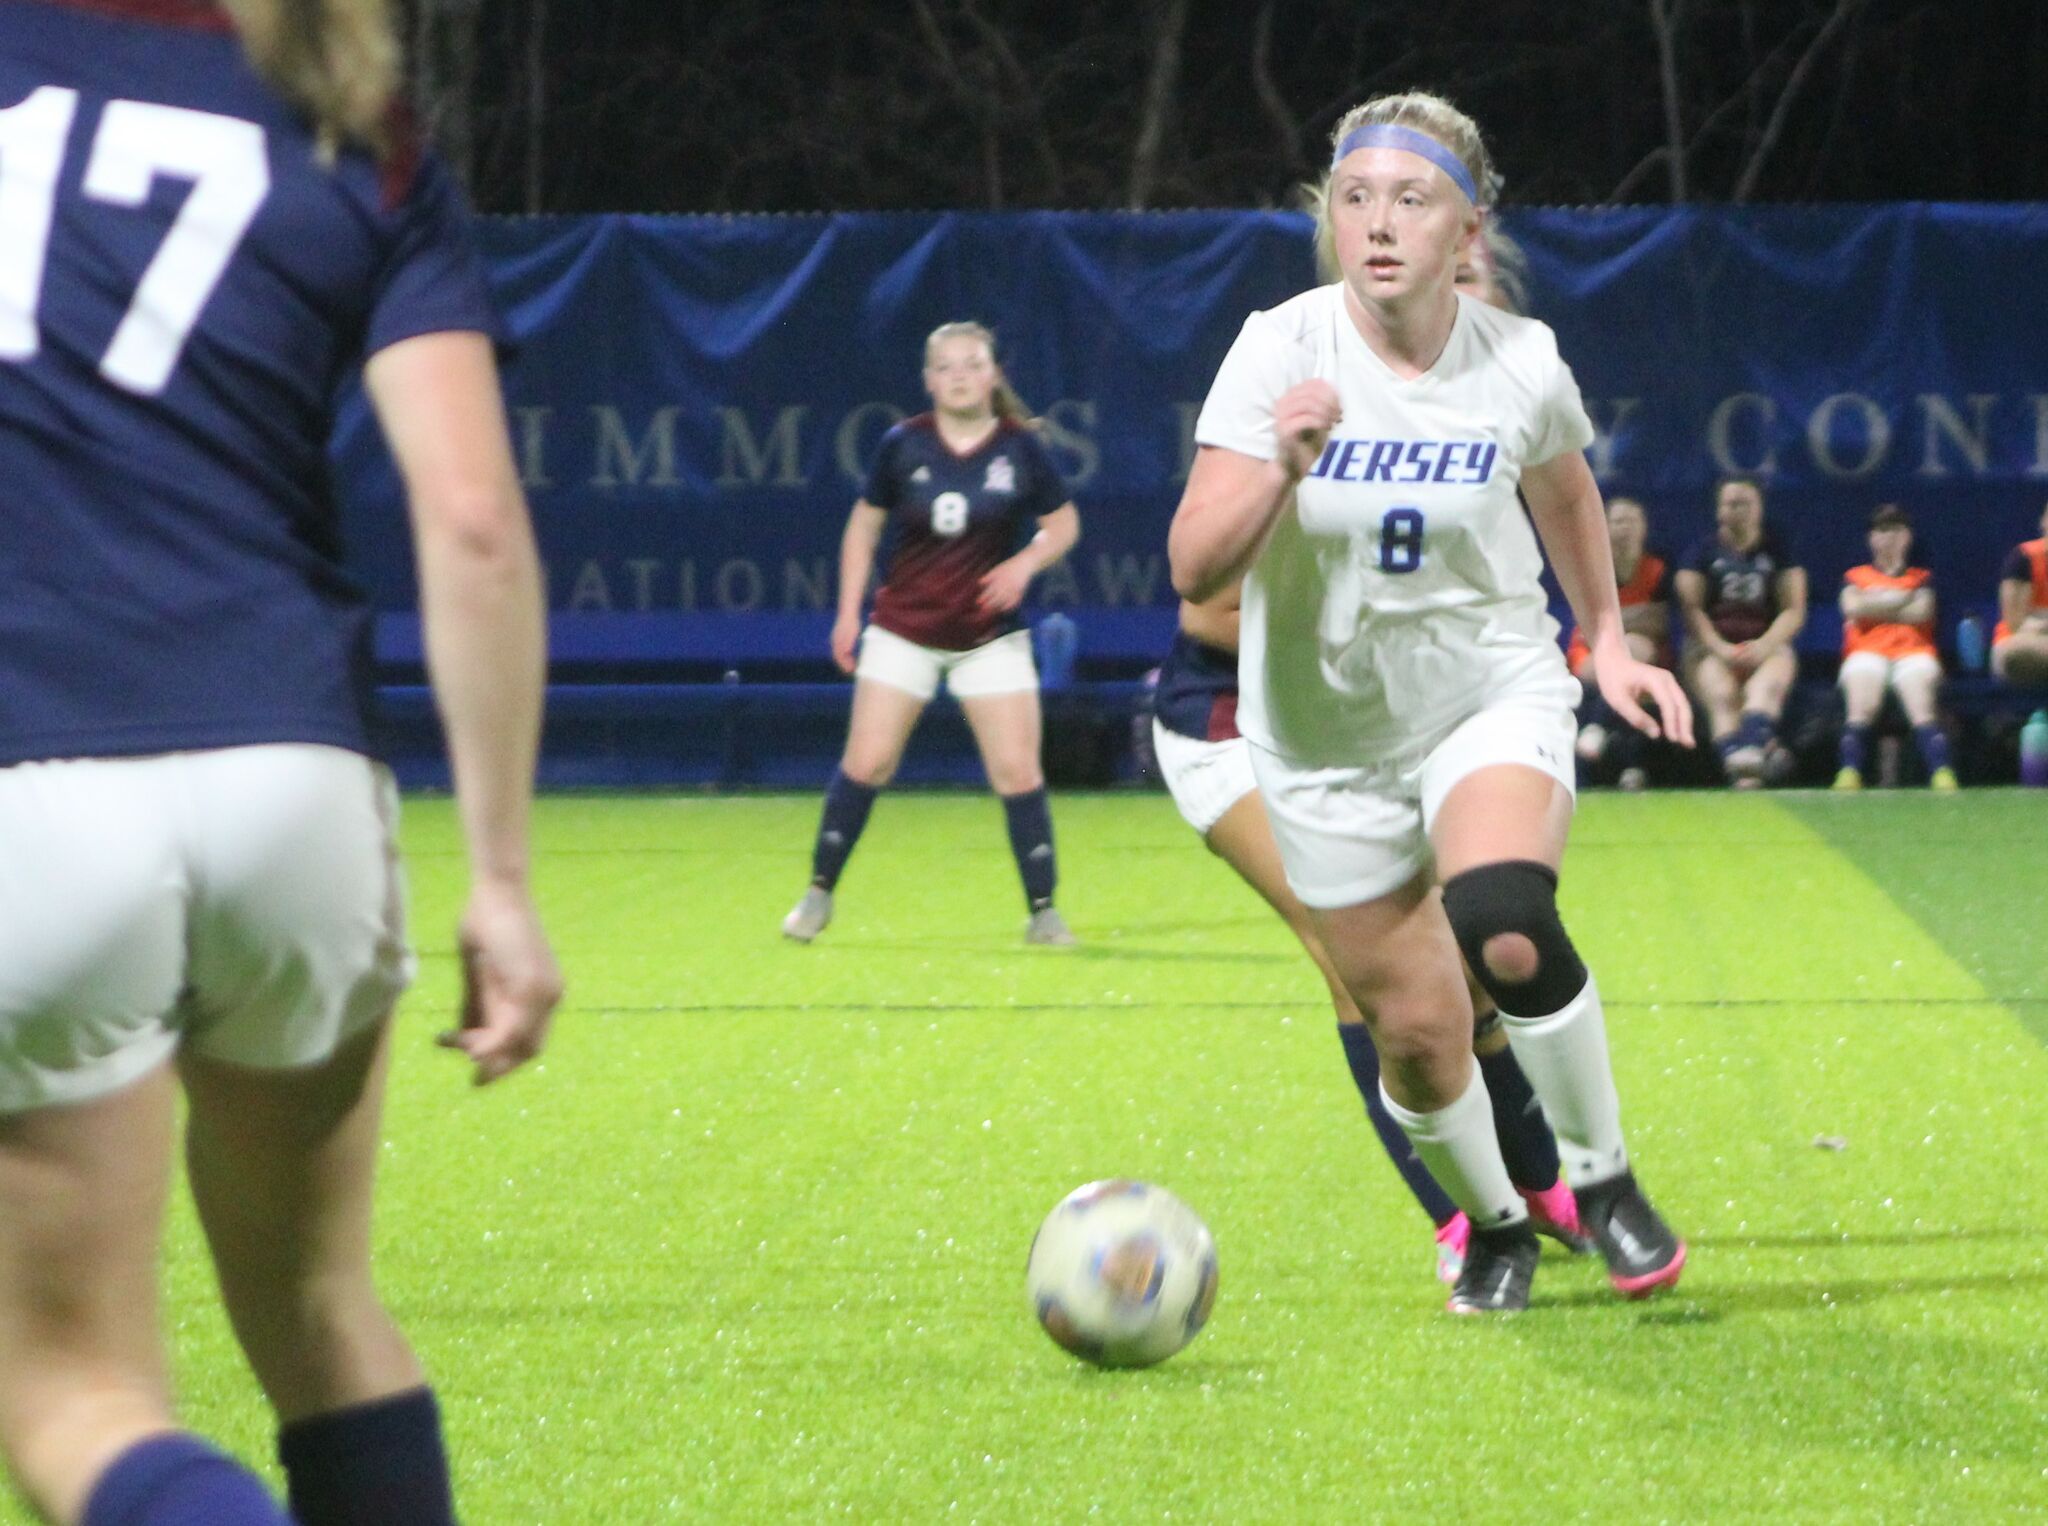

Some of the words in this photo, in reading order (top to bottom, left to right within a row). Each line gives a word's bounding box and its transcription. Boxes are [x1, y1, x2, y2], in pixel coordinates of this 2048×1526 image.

[0, 84, 271, 397] 17
[1308, 440, 1497, 483] JERSEY
[932, 491, 968, 535] 8
[1380, 507, 1425, 574] 8
